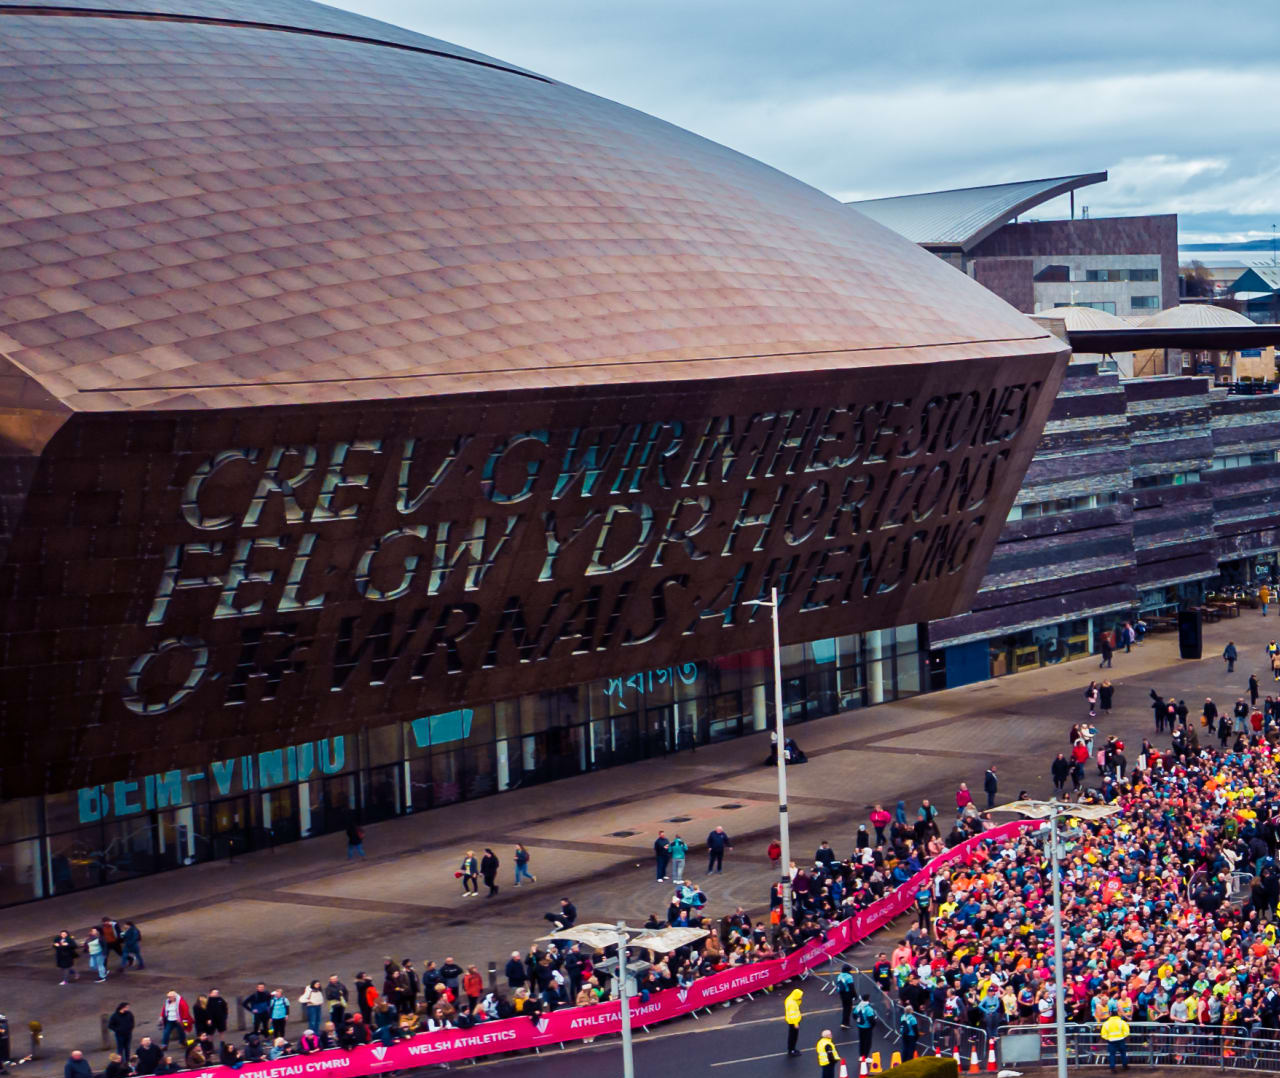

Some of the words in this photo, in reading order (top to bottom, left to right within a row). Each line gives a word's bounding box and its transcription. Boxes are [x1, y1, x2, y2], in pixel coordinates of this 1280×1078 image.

[481, 421, 685, 504] GWIR
[146, 531, 325, 627] FEL
[702, 980, 730, 998] WELSH
[731, 969, 770, 988] ATHLETICS
[629, 1002, 661, 1019] CYMRU
[408, 1040, 451, 1056] WELSH
[454, 1030, 516, 1049] ATHLETICS
[306, 1058, 350, 1073] CYMRU
